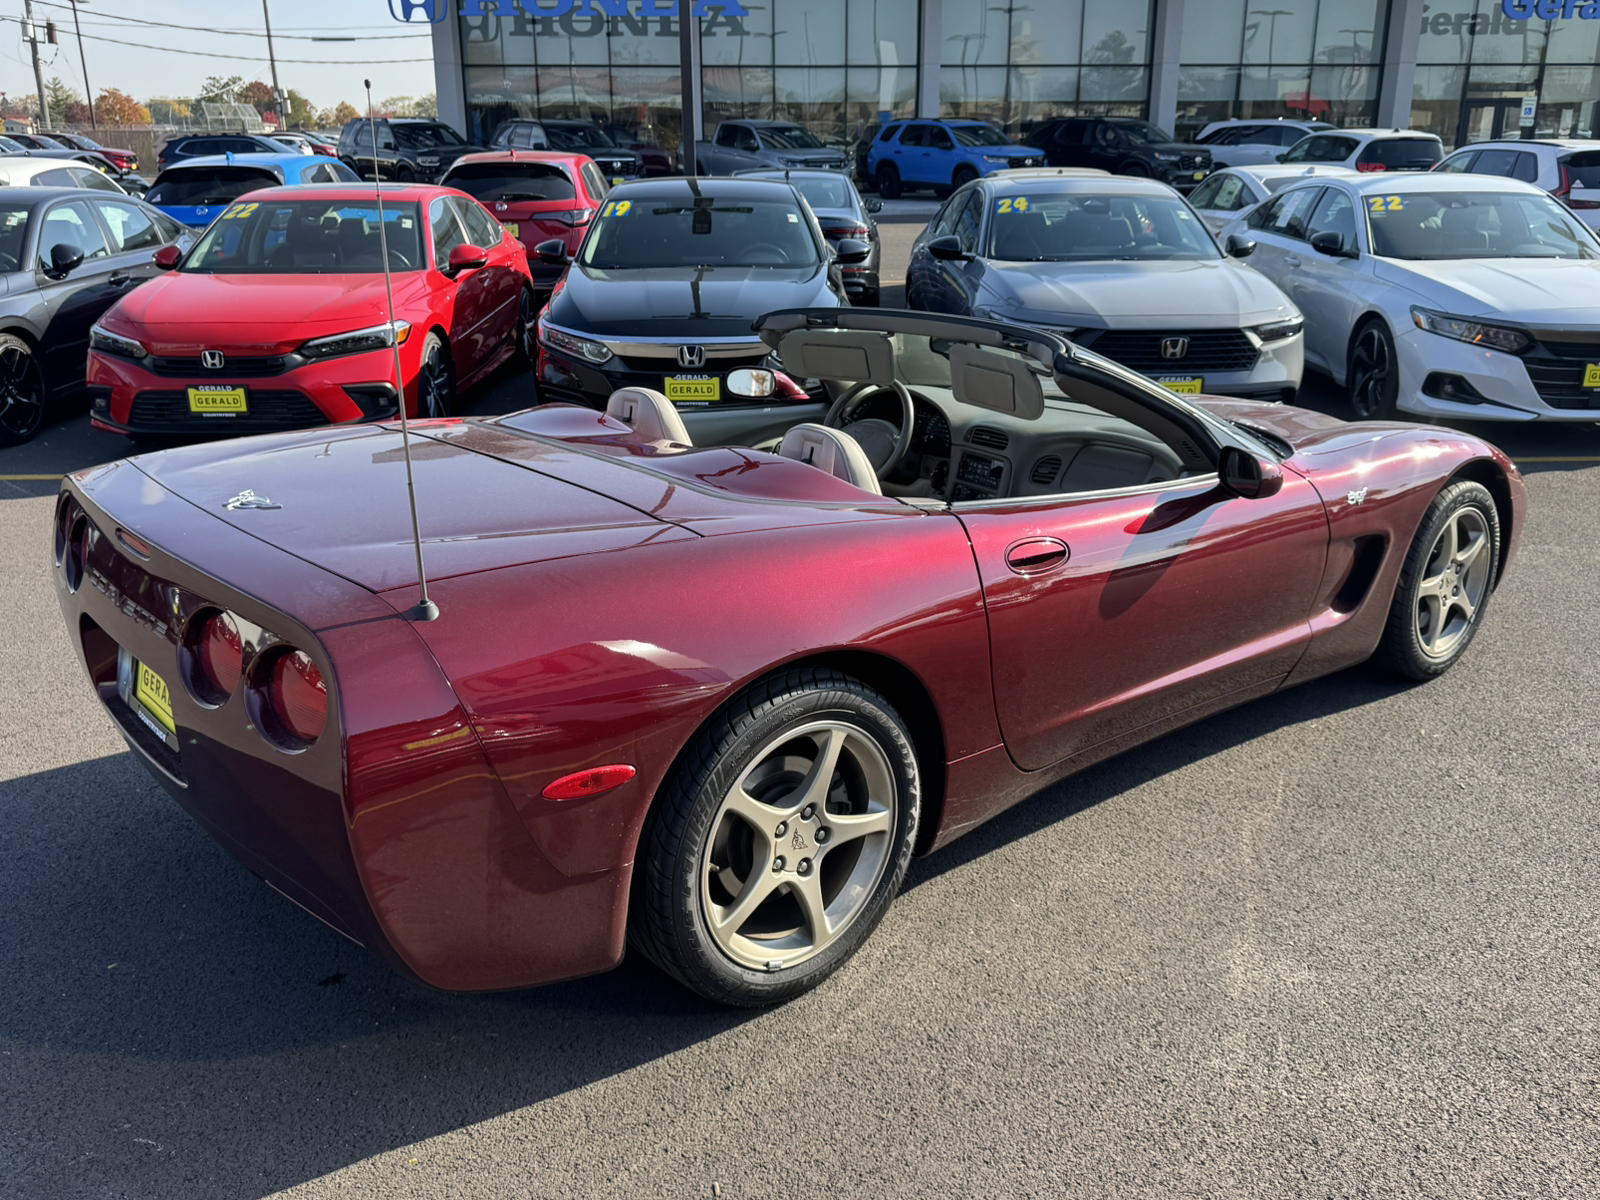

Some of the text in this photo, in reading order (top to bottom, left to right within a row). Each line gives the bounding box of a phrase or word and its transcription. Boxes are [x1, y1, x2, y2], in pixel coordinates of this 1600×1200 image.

[222, 202, 260, 220] 22
[602, 200, 632, 218] 19
[997, 196, 1029, 214] 24
[1369, 195, 1404, 212] 22
[671, 386, 713, 394] GERALD
[197, 397, 239, 405] GERALD
